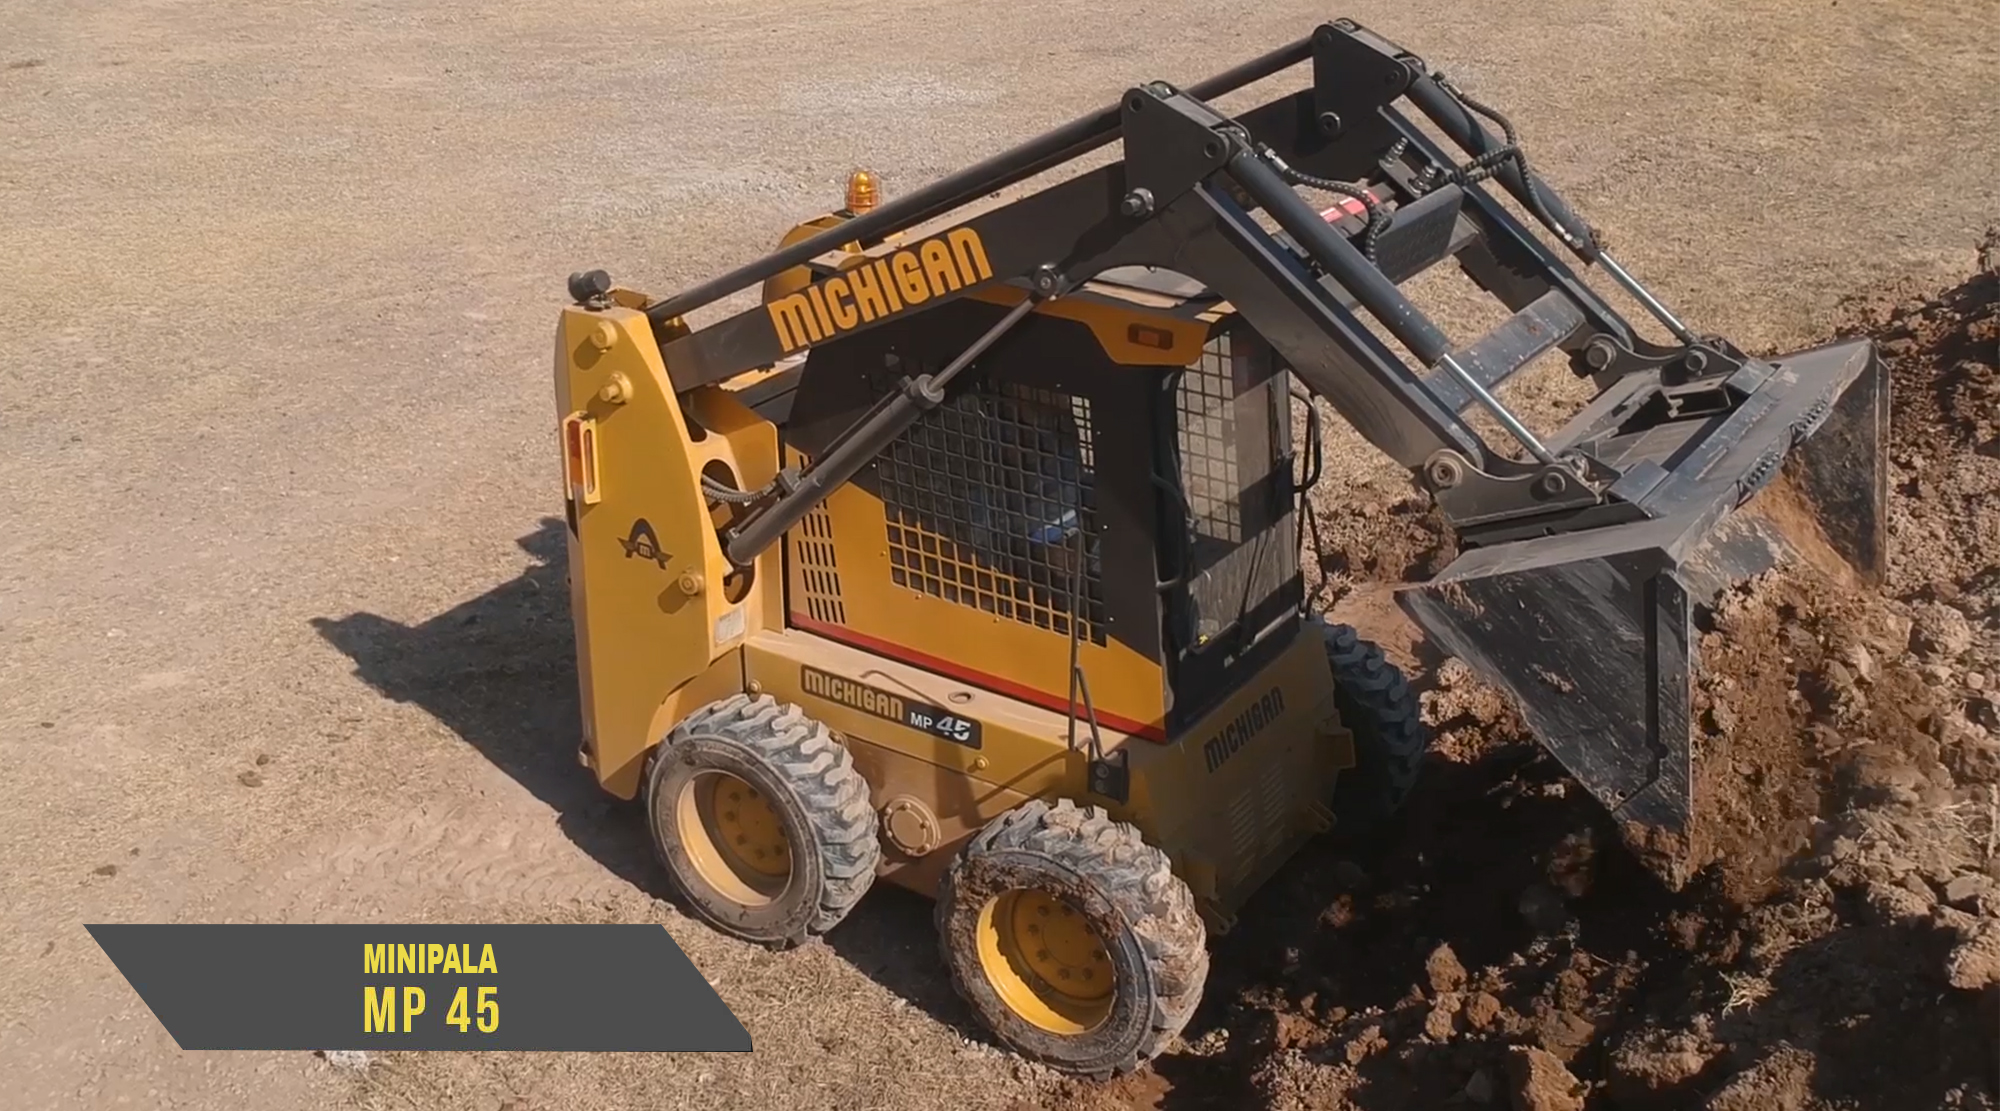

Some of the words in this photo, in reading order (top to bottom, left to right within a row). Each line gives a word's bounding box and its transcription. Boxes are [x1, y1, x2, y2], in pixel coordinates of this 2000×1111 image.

[767, 226, 994, 353] MICHIGAN
[804, 668, 904, 722] MICHIGAN
[910, 711, 933, 729] MP
[936, 715, 971, 742] 45
[1203, 685, 1286, 775] MICHIGAN
